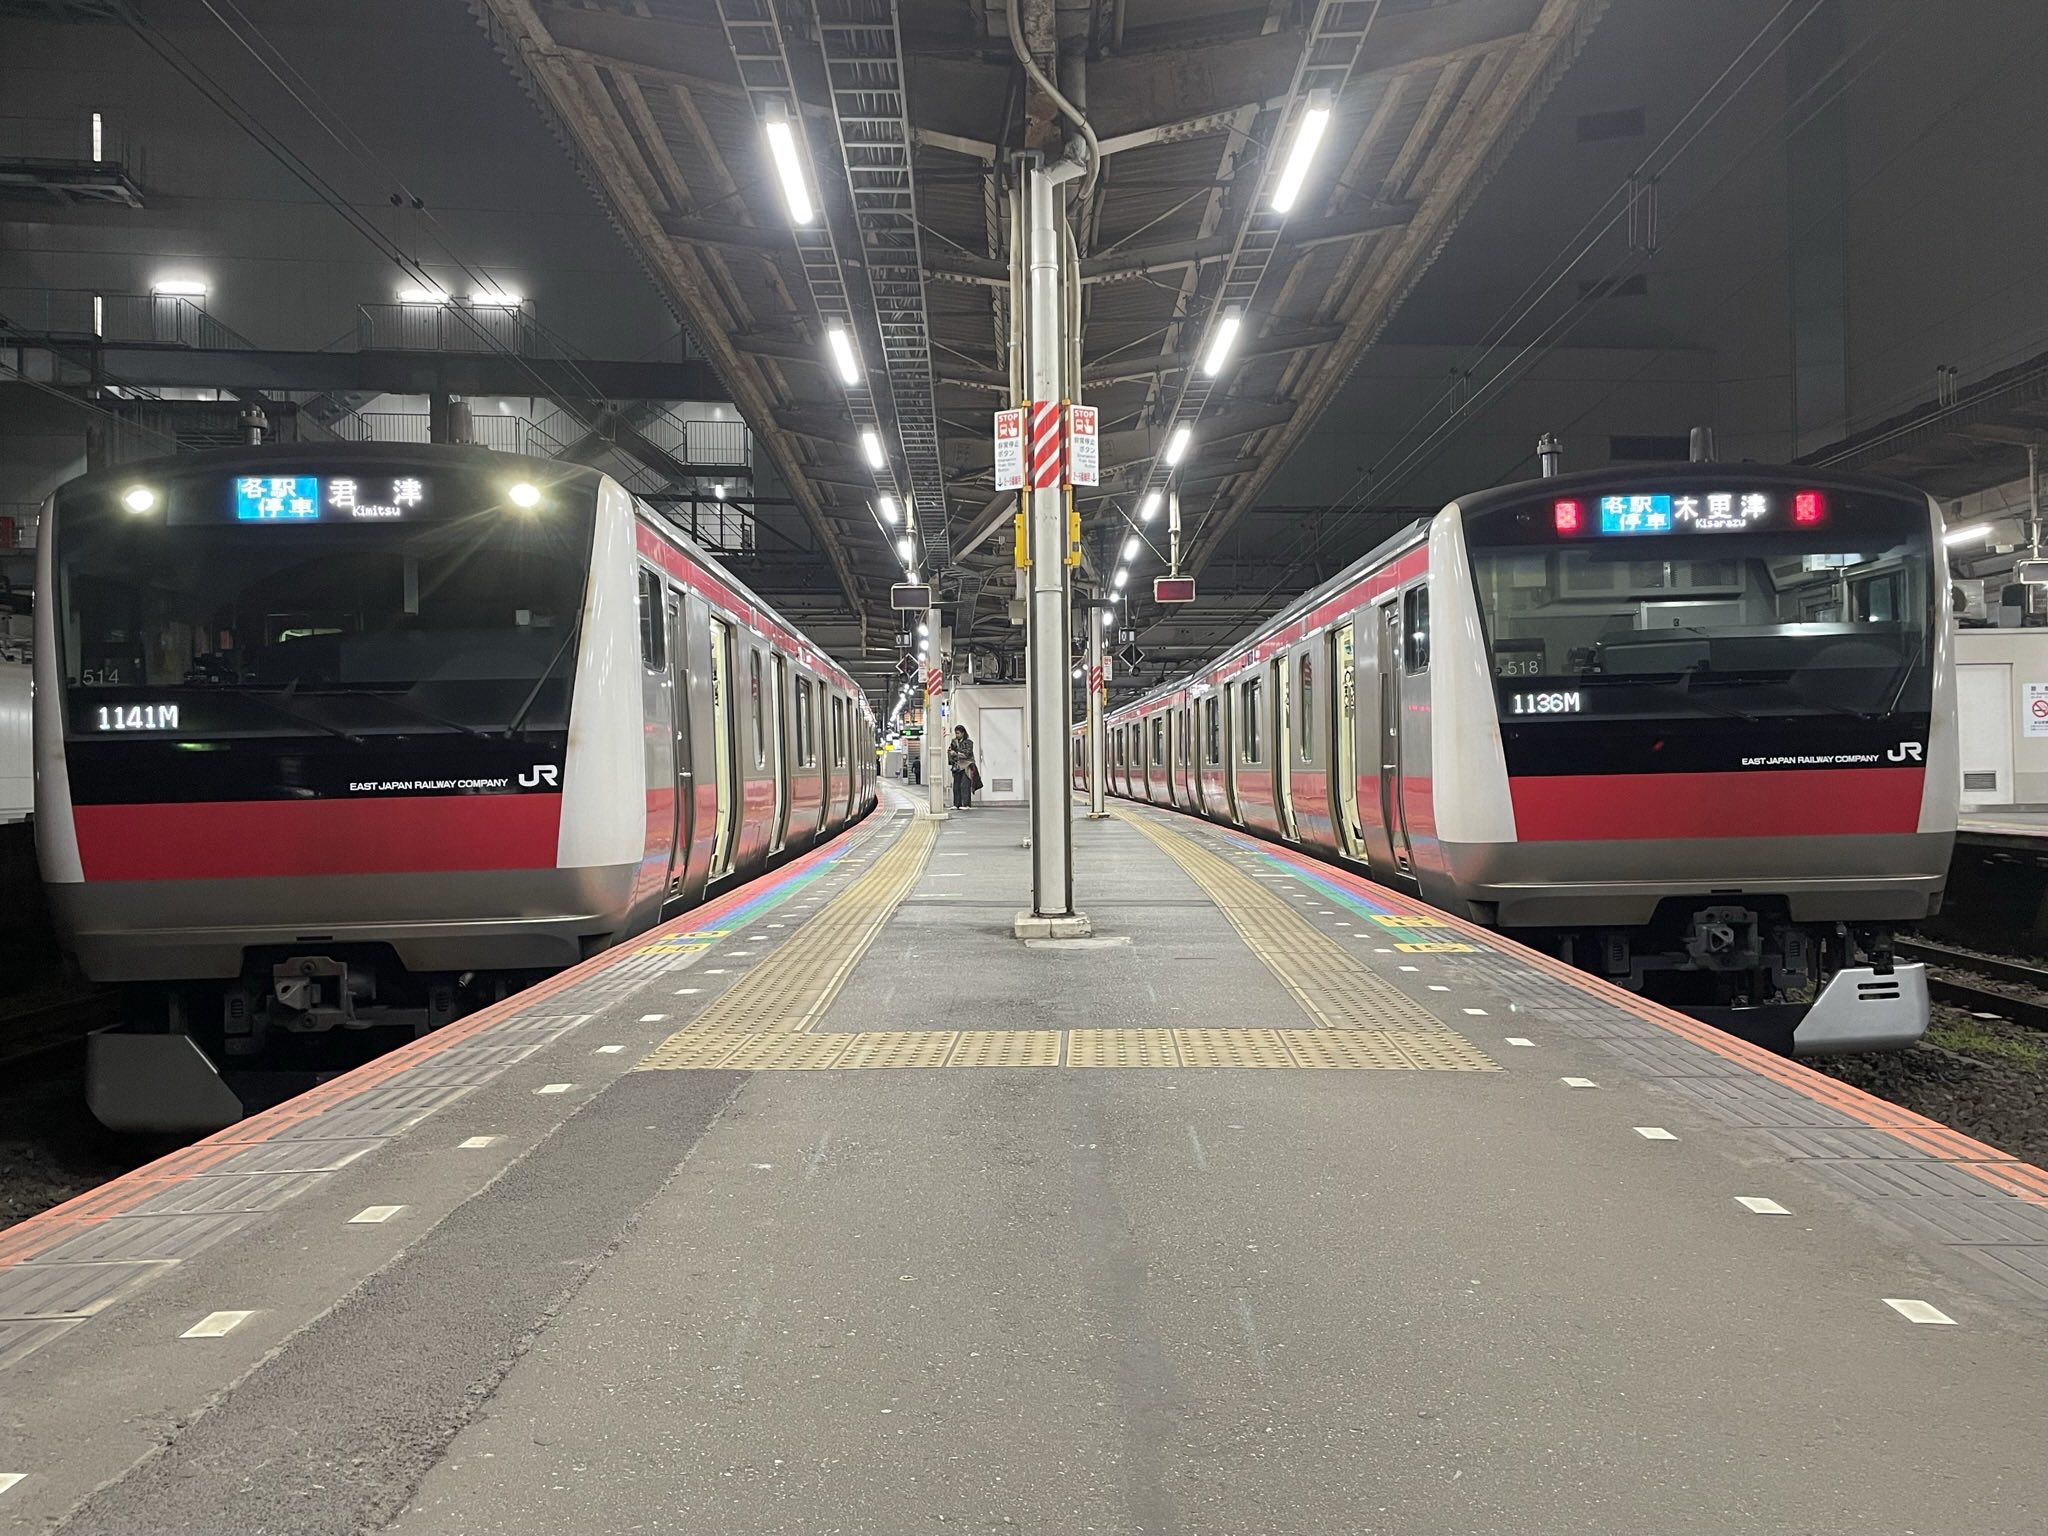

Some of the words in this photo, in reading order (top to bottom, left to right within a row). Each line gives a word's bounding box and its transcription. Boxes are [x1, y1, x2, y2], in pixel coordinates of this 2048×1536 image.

[998, 413, 1018, 423] STOP
[1075, 409, 1094, 418] STOP
[241, 478, 297, 499] 各駅
[258, 497, 315, 518] 停車
[352, 505, 401, 518] Kimitsu
[1605, 496, 1653, 514] 各駅
[1674, 494, 1767, 521] 木更津
[1620, 513, 1668, 530] 停車
[1695, 518, 1746, 529] Kisarazu
[82, 668, 120, 685] 514
[1507, 661, 1539, 675] 518
[1514, 692, 1581, 714] 1136M
[98, 705, 179, 730] 1141M
[1742, 757, 1766, 766] EAST
[1766, 757, 1797, 765] JAPAN
[1797, 756, 1835, 764] RAILWAY
[1835, 754, 1880, 763] COMPANY
[1887, 742, 1923, 762] JR
[518, 764, 559, 787] JR
[349, 782, 379, 791] EAST
[379, 781, 413, 790] JAPAN
[414, 780, 457, 789] RAILWAY
[457, 778, 508, 788] COMPANY
